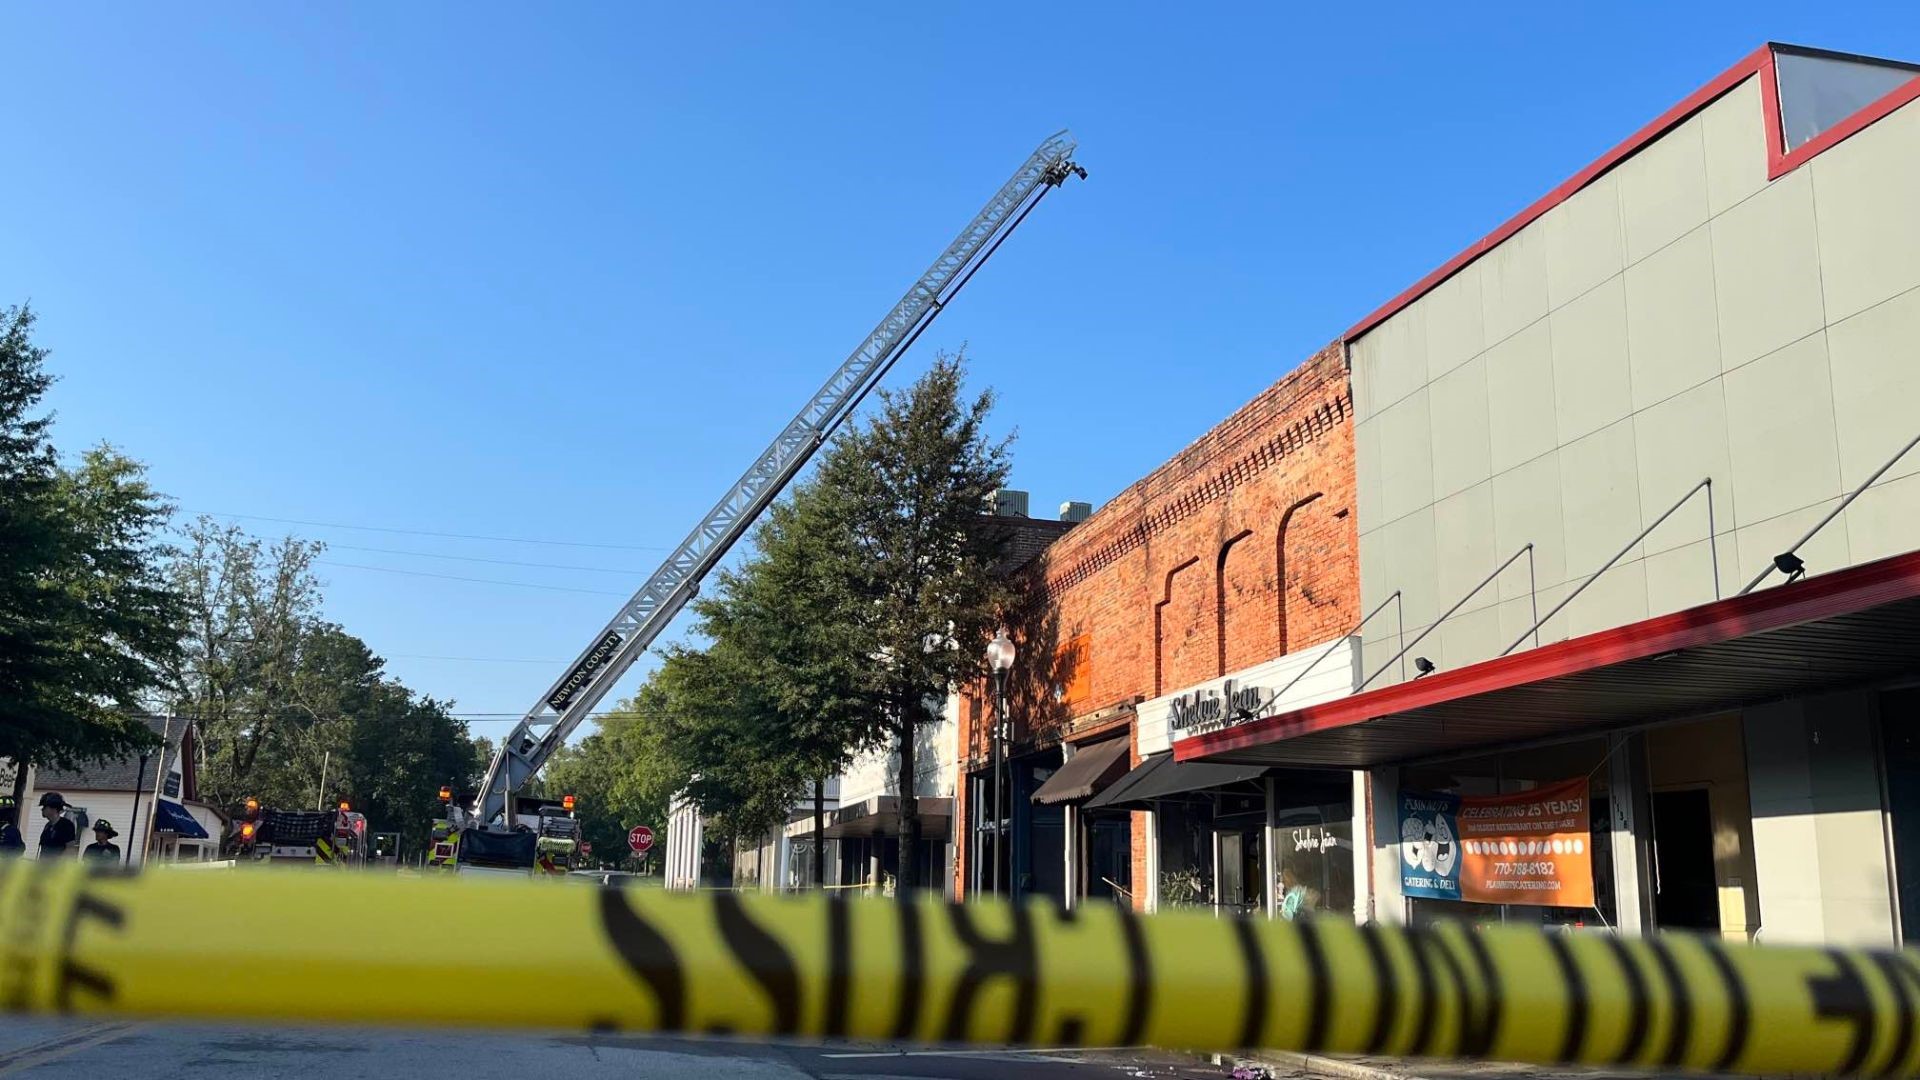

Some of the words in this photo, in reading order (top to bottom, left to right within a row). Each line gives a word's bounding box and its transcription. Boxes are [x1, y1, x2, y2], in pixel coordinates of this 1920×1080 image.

[551, 668, 588, 708] NEWTON
[585, 632, 620, 670] COUNTY
[1223, 679, 1261, 727] Jean
[1462, 805, 1526, 818] CELEBRATING
[1527, 803, 1541, 817] 25
[630, 833, 652, 845] STOP
[1494, 861, 1555, 876] 770-788-8182
